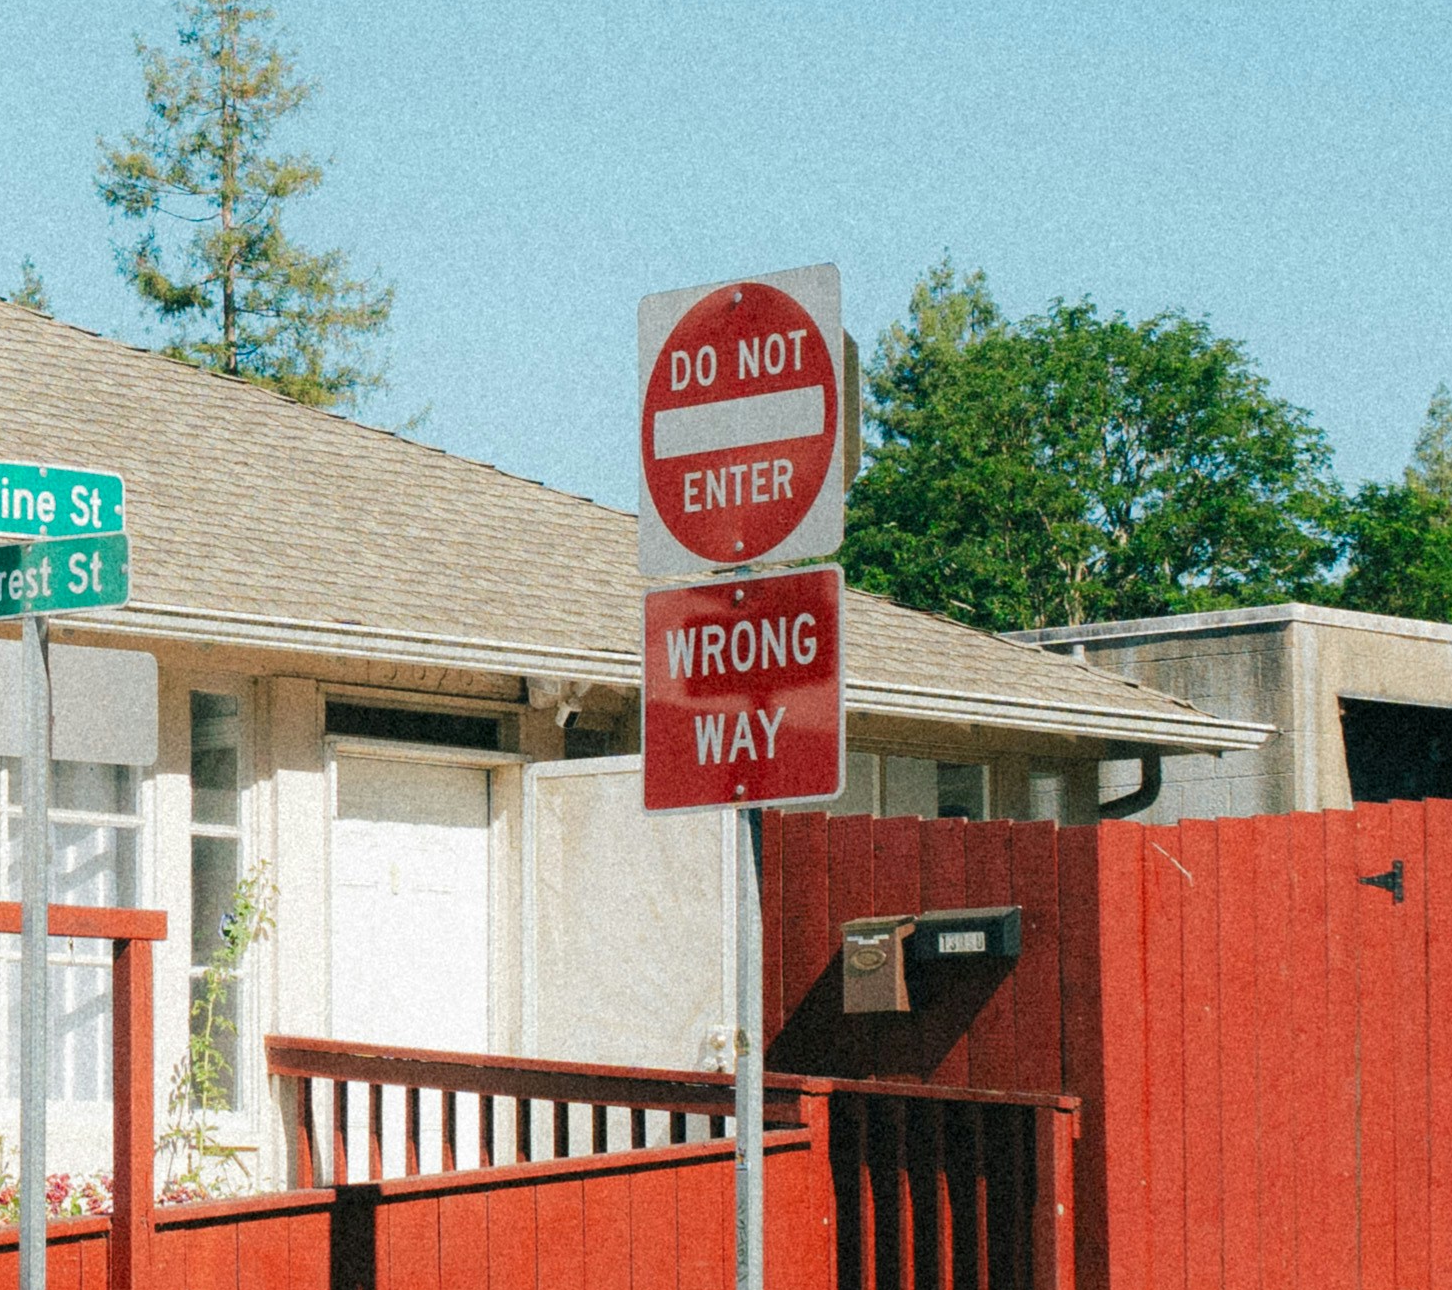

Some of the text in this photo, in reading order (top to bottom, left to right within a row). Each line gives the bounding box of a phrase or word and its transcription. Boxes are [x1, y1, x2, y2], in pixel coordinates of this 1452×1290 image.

[671, 329, 808, 392] DO NOT
[69, 485, 102, 528] St
[684, 458, 794, 513] ENTER
[68, 551, 103, 594] St
[665, 613, 818, 680] WRONG
[694, 706, 787, 766] WAY
